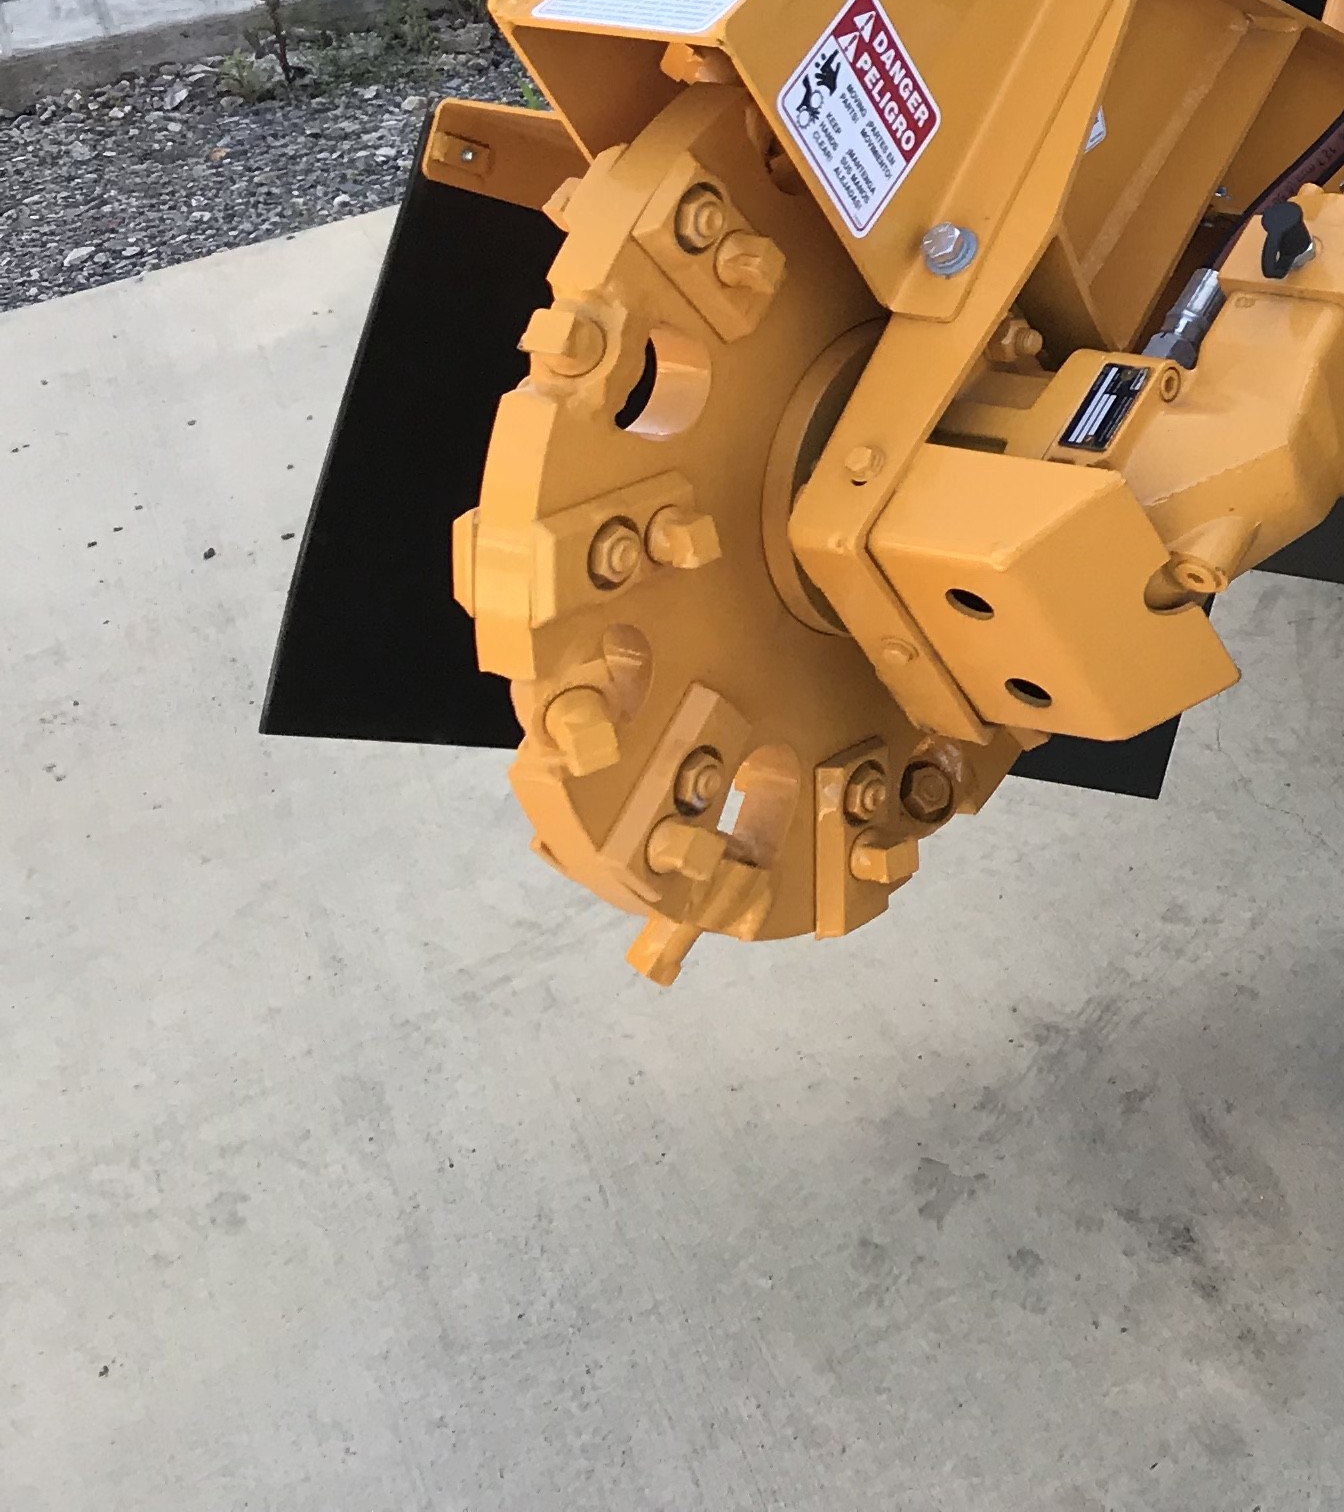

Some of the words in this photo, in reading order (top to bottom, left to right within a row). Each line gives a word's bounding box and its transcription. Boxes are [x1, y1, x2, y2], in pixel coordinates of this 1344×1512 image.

[872, 31, 930, 127] DANGER
[846, 84, 867, 118] MOVING
[856, 51, 916, 151] PELIGRO
[818, 119, 839, 152] HANDS
[825, 110, 842, 136] KEEP
[850, 172, 870, 205] MANOS
